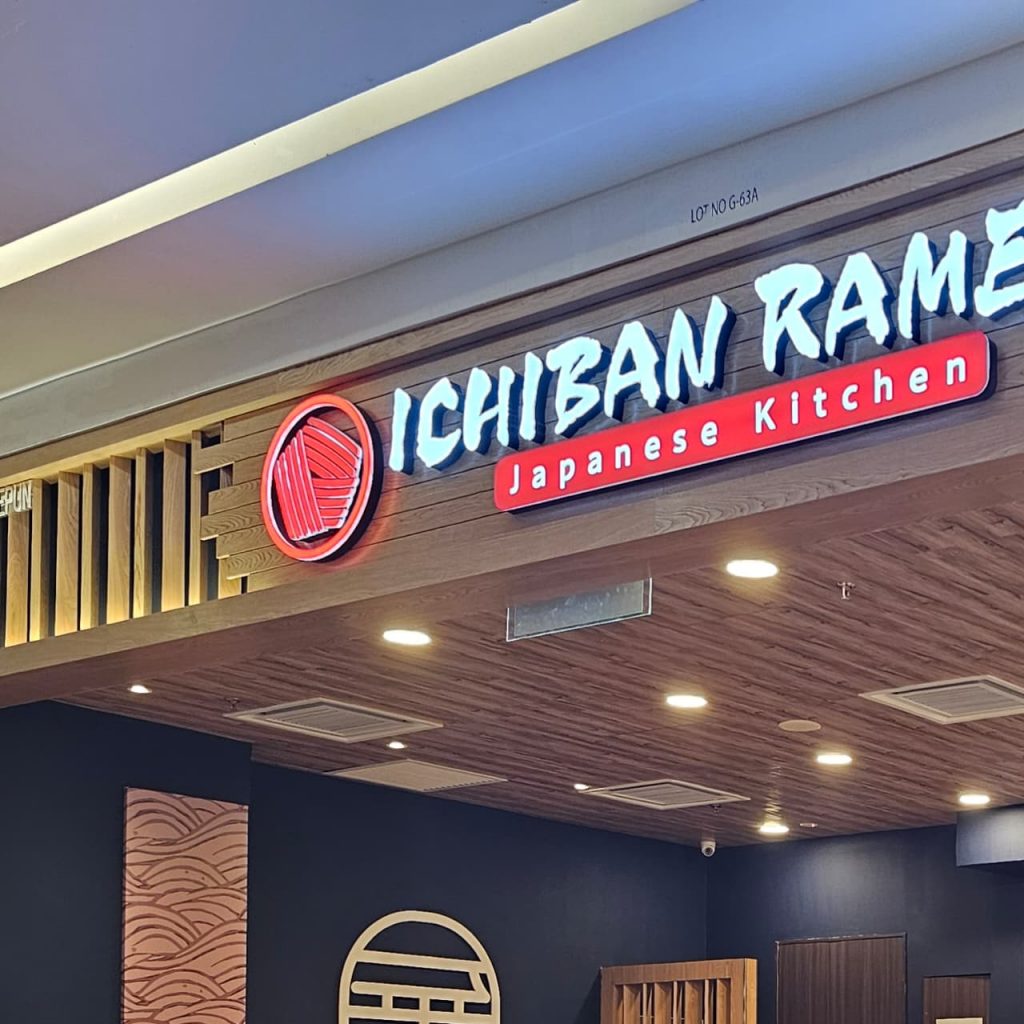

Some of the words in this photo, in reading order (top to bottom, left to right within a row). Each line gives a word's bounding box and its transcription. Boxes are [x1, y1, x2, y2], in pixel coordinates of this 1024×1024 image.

[690, 204, 709, 224] LOT
[711, 198, 726, 216] NO
[728, 187, 759, 210] G-63A
[389, 297, 729, 473] ICHIBAN
[509, 419, 718, 495] Japanese
[754, 355, 967, 433] Kitchen
